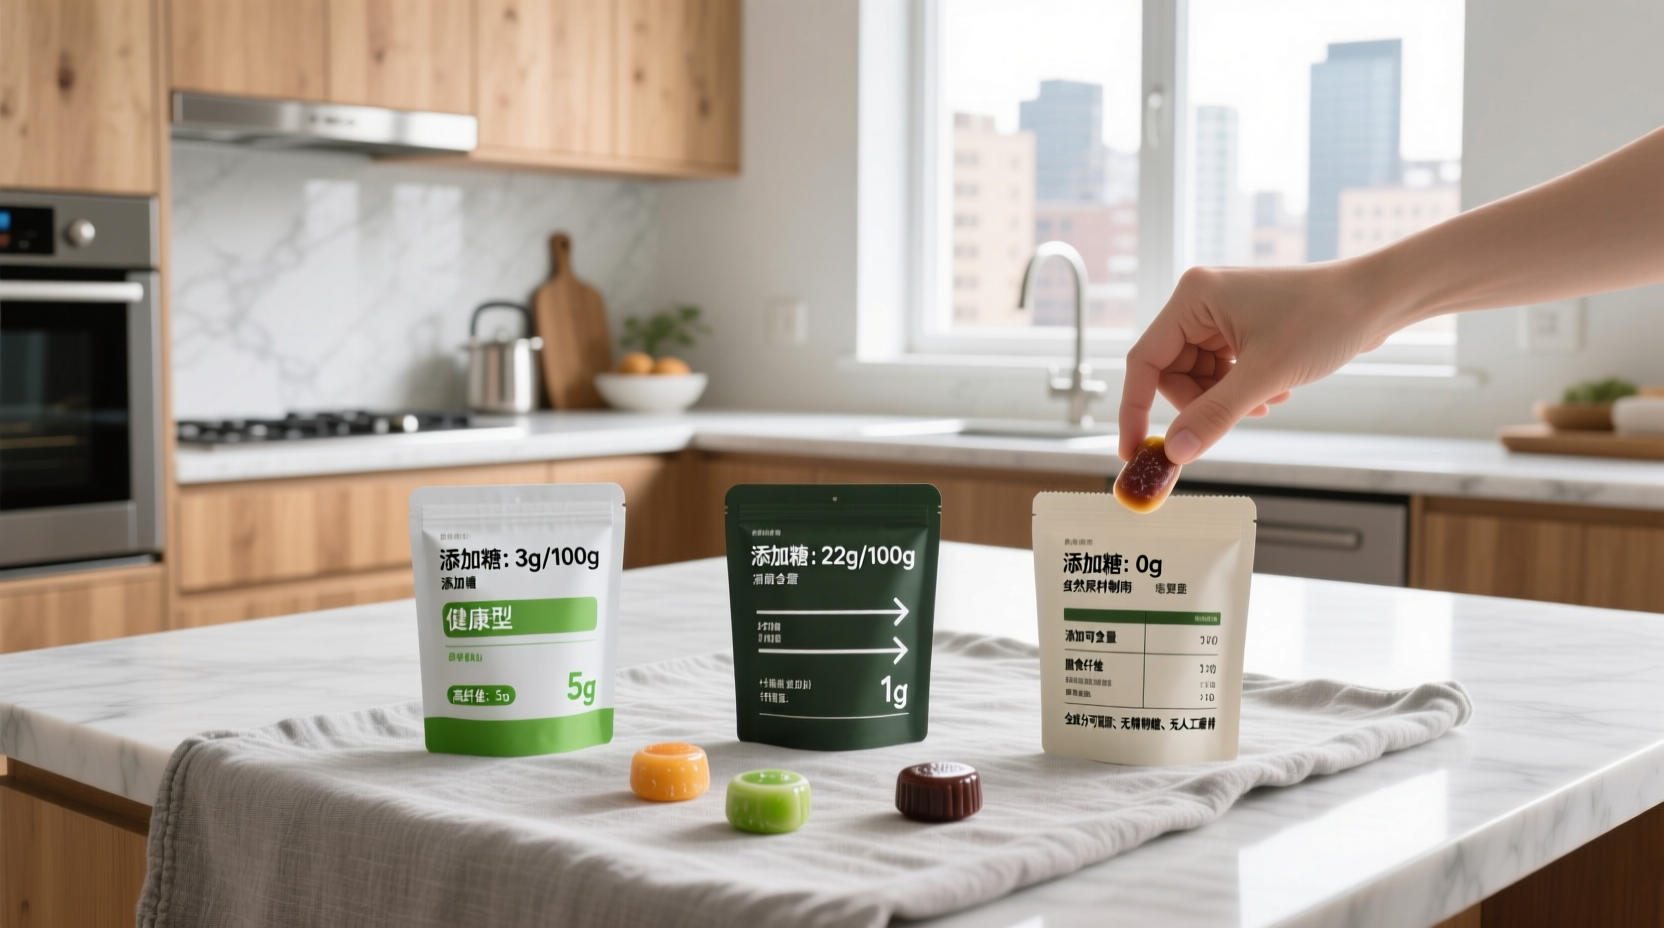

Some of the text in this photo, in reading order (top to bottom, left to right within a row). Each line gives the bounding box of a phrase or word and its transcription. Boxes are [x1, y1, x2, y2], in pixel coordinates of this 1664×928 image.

[446, 605, 513, 632] 健康型
[567, 671, 596, 706] 5g
[881, 675, 908, 709] 1g
